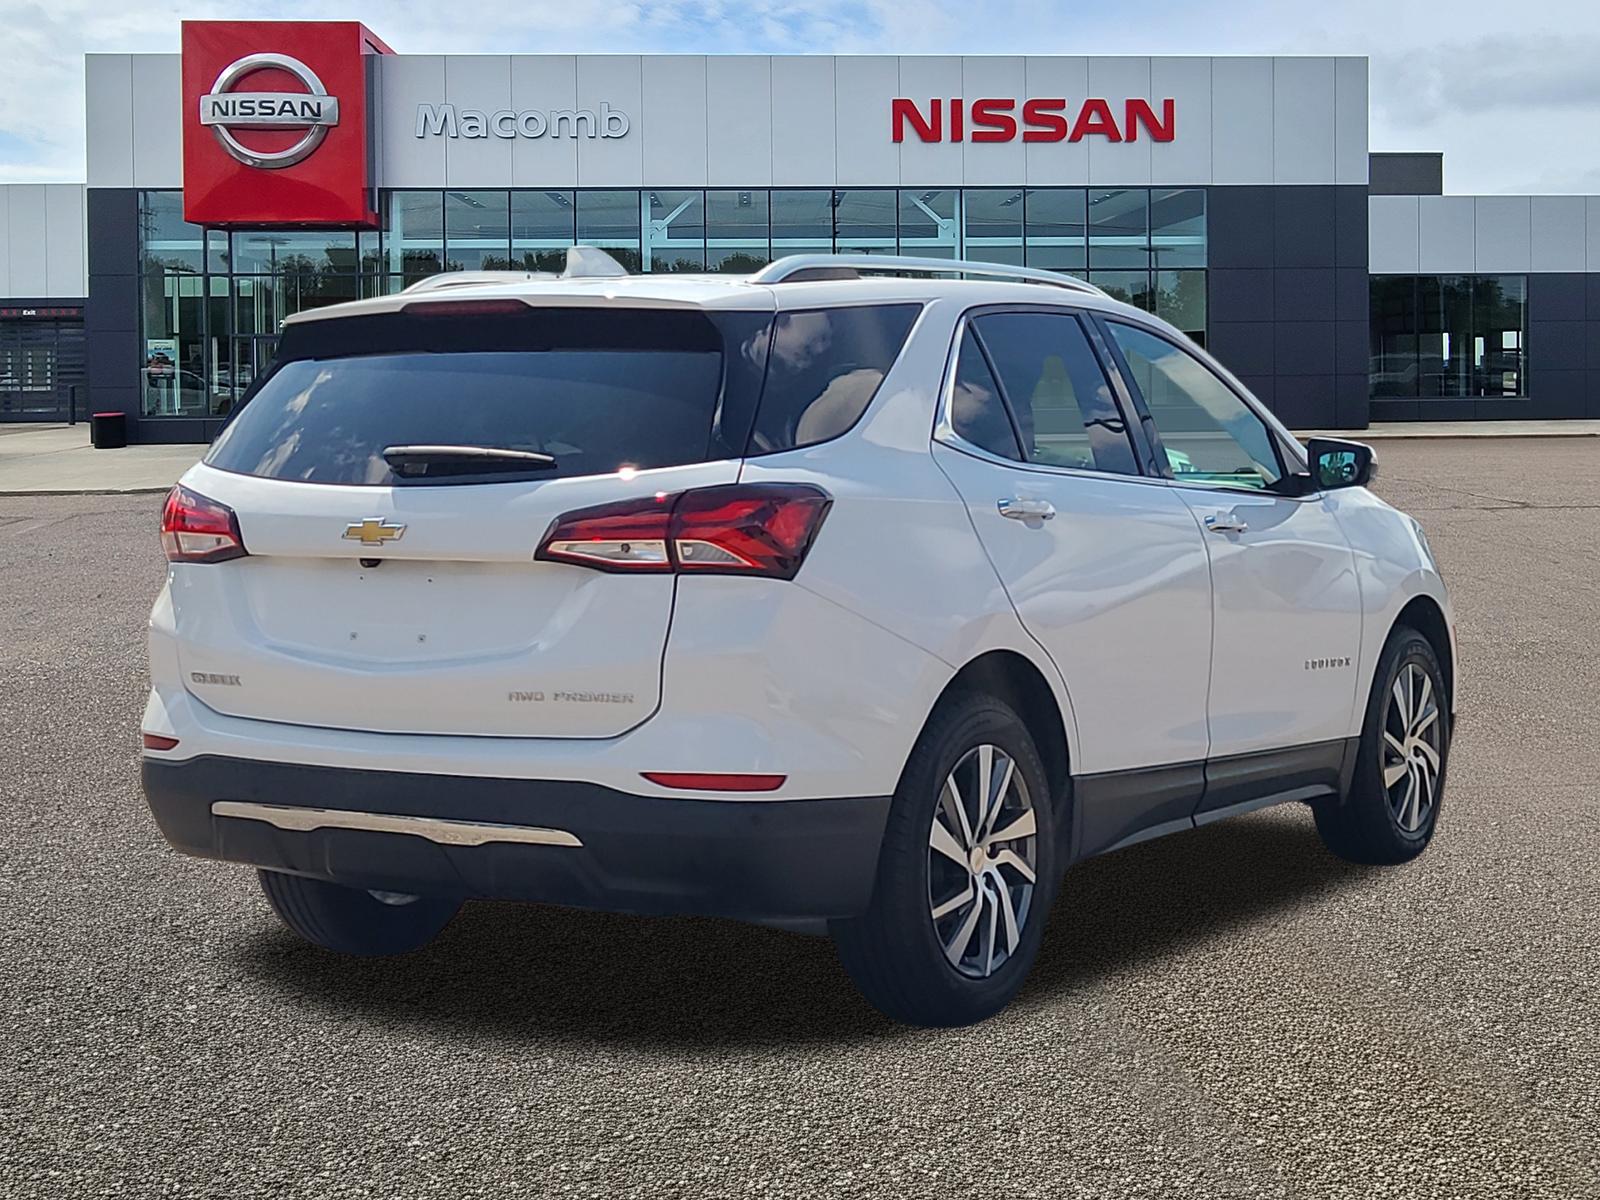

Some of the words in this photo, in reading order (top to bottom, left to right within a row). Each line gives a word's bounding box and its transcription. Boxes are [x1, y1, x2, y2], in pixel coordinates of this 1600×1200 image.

[211, 100, 322, 117] NISSAN
[415, 101, 630, 139] Macomb
[890, 98, 1175, 143] NISSAN
[1304, 657, 1350, 670] EQUINOX
[508, 691, 545, 702] AWD
[553, 692, 634, 704] PREMIER
